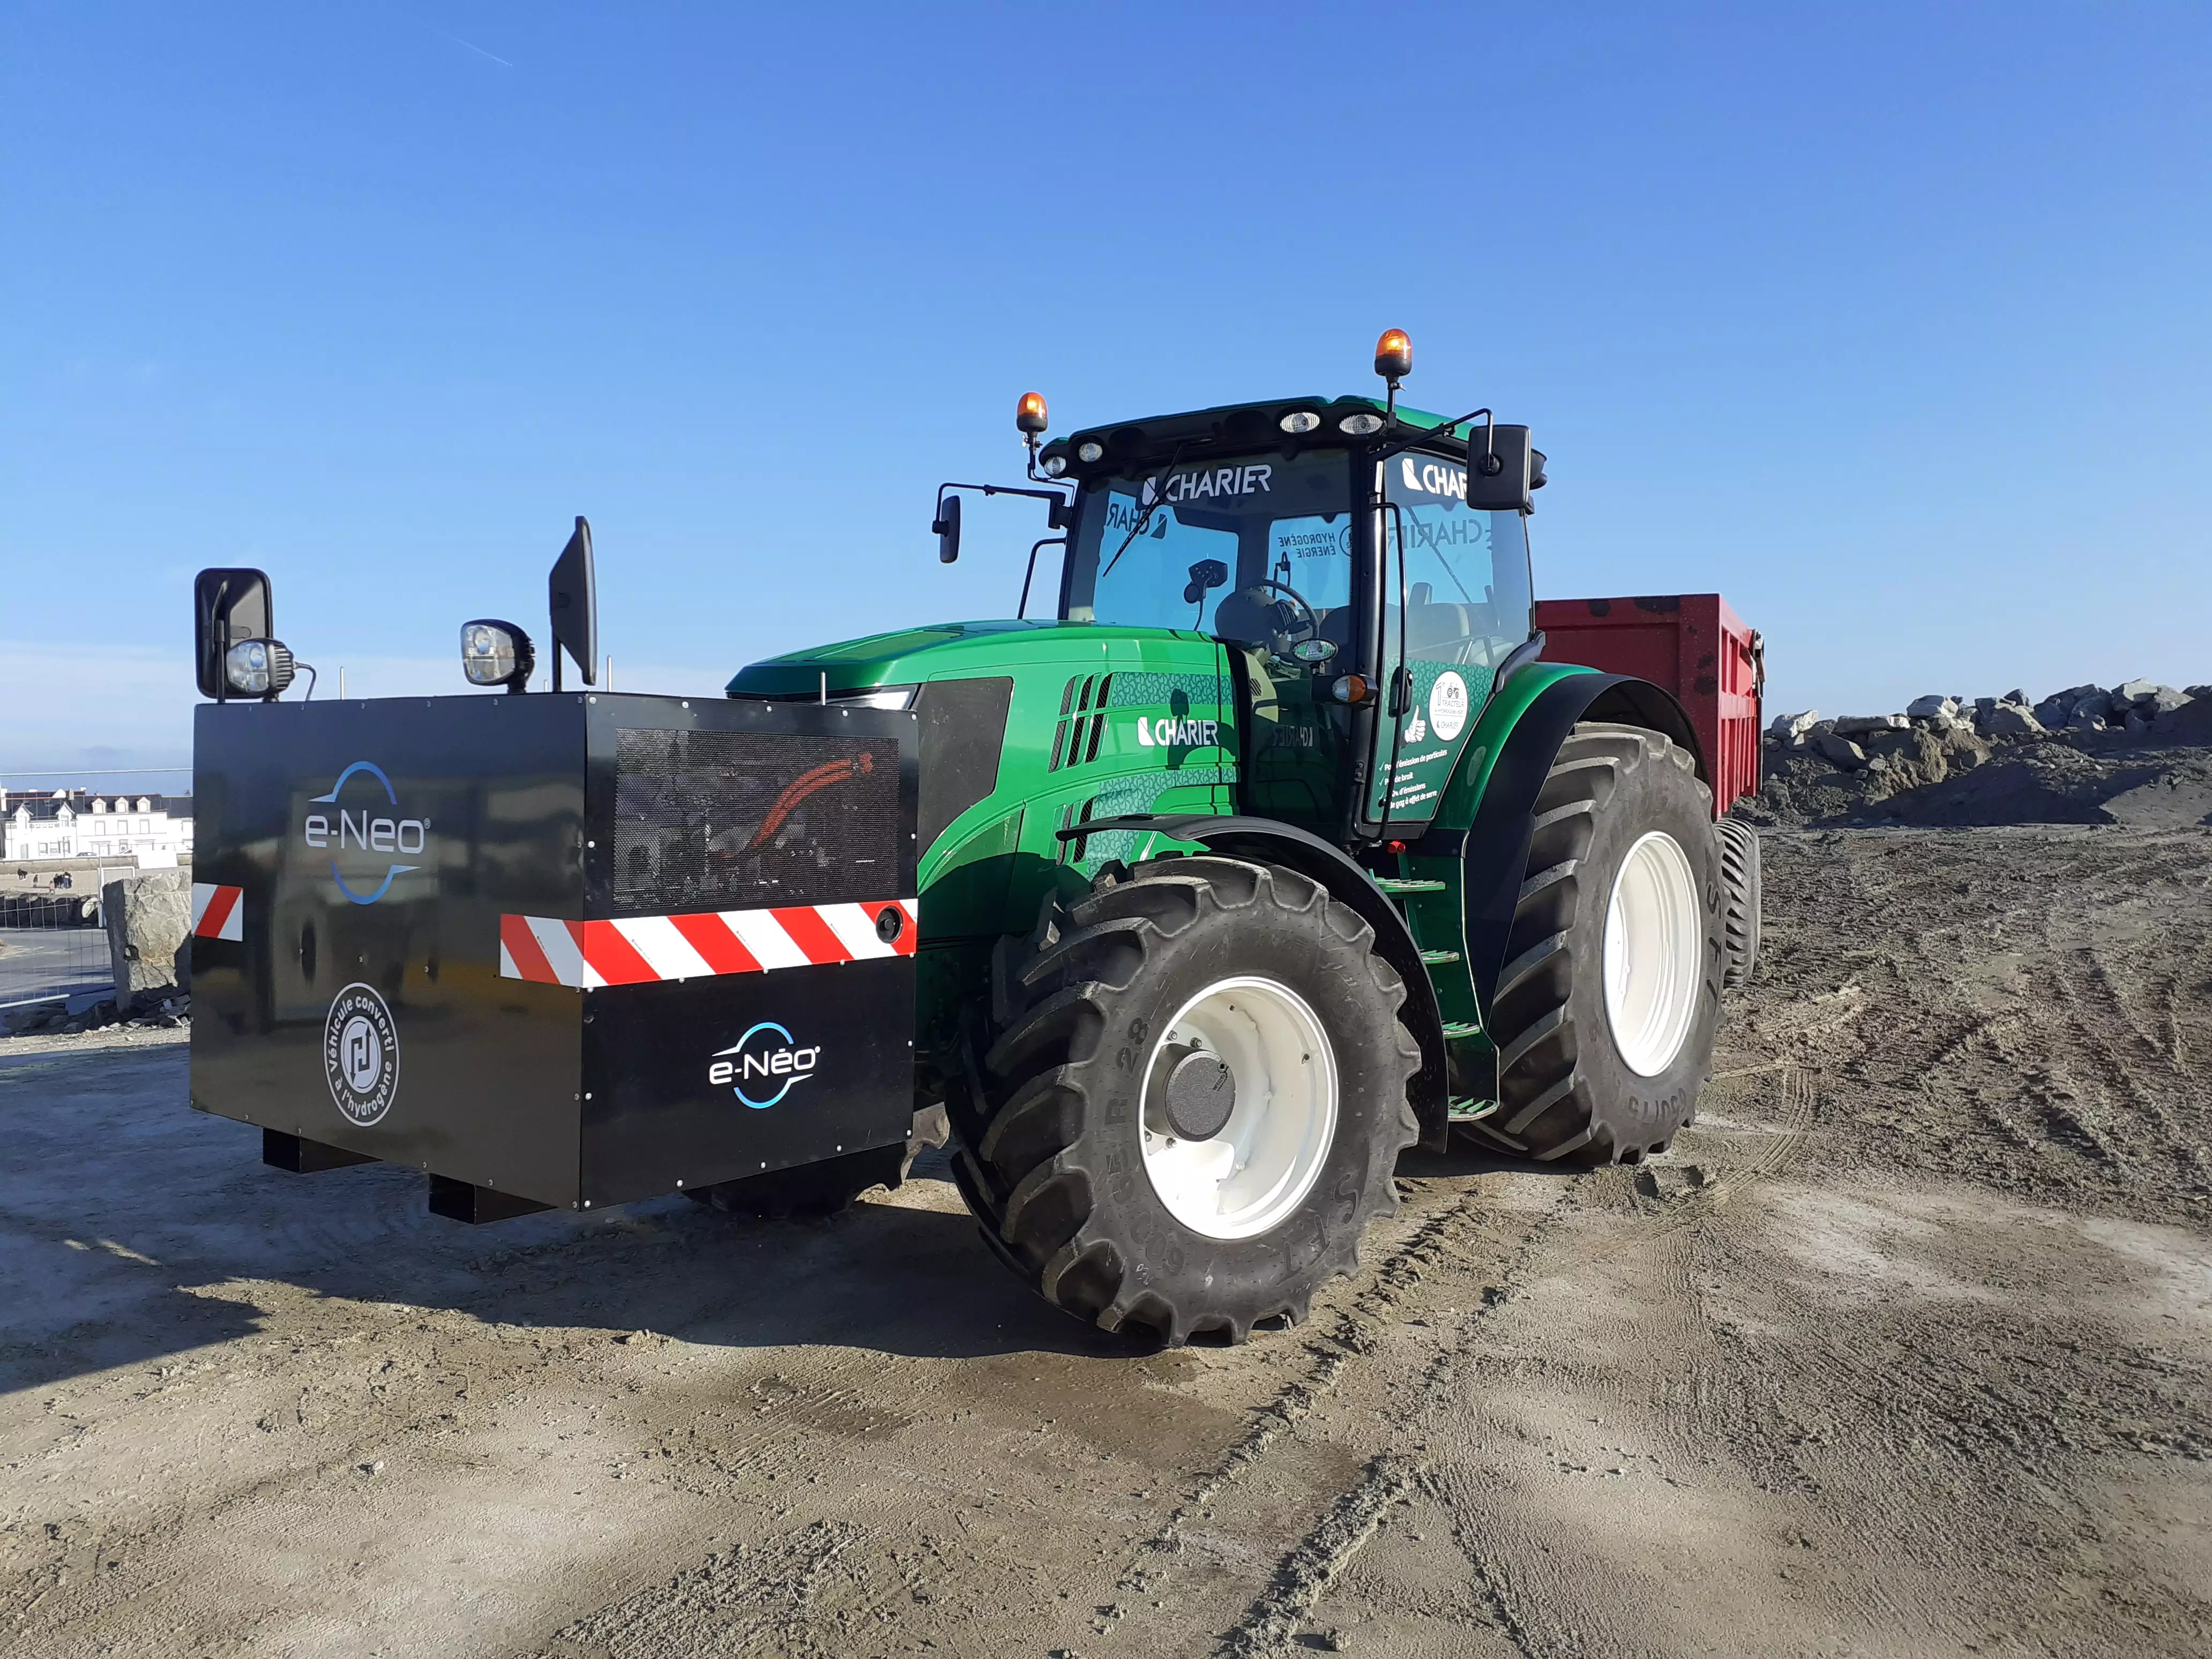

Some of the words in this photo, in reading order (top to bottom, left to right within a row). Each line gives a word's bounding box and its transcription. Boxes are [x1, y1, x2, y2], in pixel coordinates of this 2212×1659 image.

[1165, 464, 1272, 502] CHARIER
[1423, 465, 1467, 500] CHAR
[1155, 719, 1219, 746] CHARIER
[1426, 750, 1447, 762] particules
[1399, 783, 1425, 795] d'émissions
[1402, 772, 1413, 781] bruit
[1395, 798, 1404, 809] gaz
[1409, 794, 1419, 804] effet
[1426, 790, 1437, 798] serre
[328, 998, 353, 1073] Véhicule
[355, 996, 394, 1051] converti
[1116, 1017, 1151, 1073] 28
[335, 1077, 343, 1091] à
[341, 1062, 392, 1118] l'hydrogène
